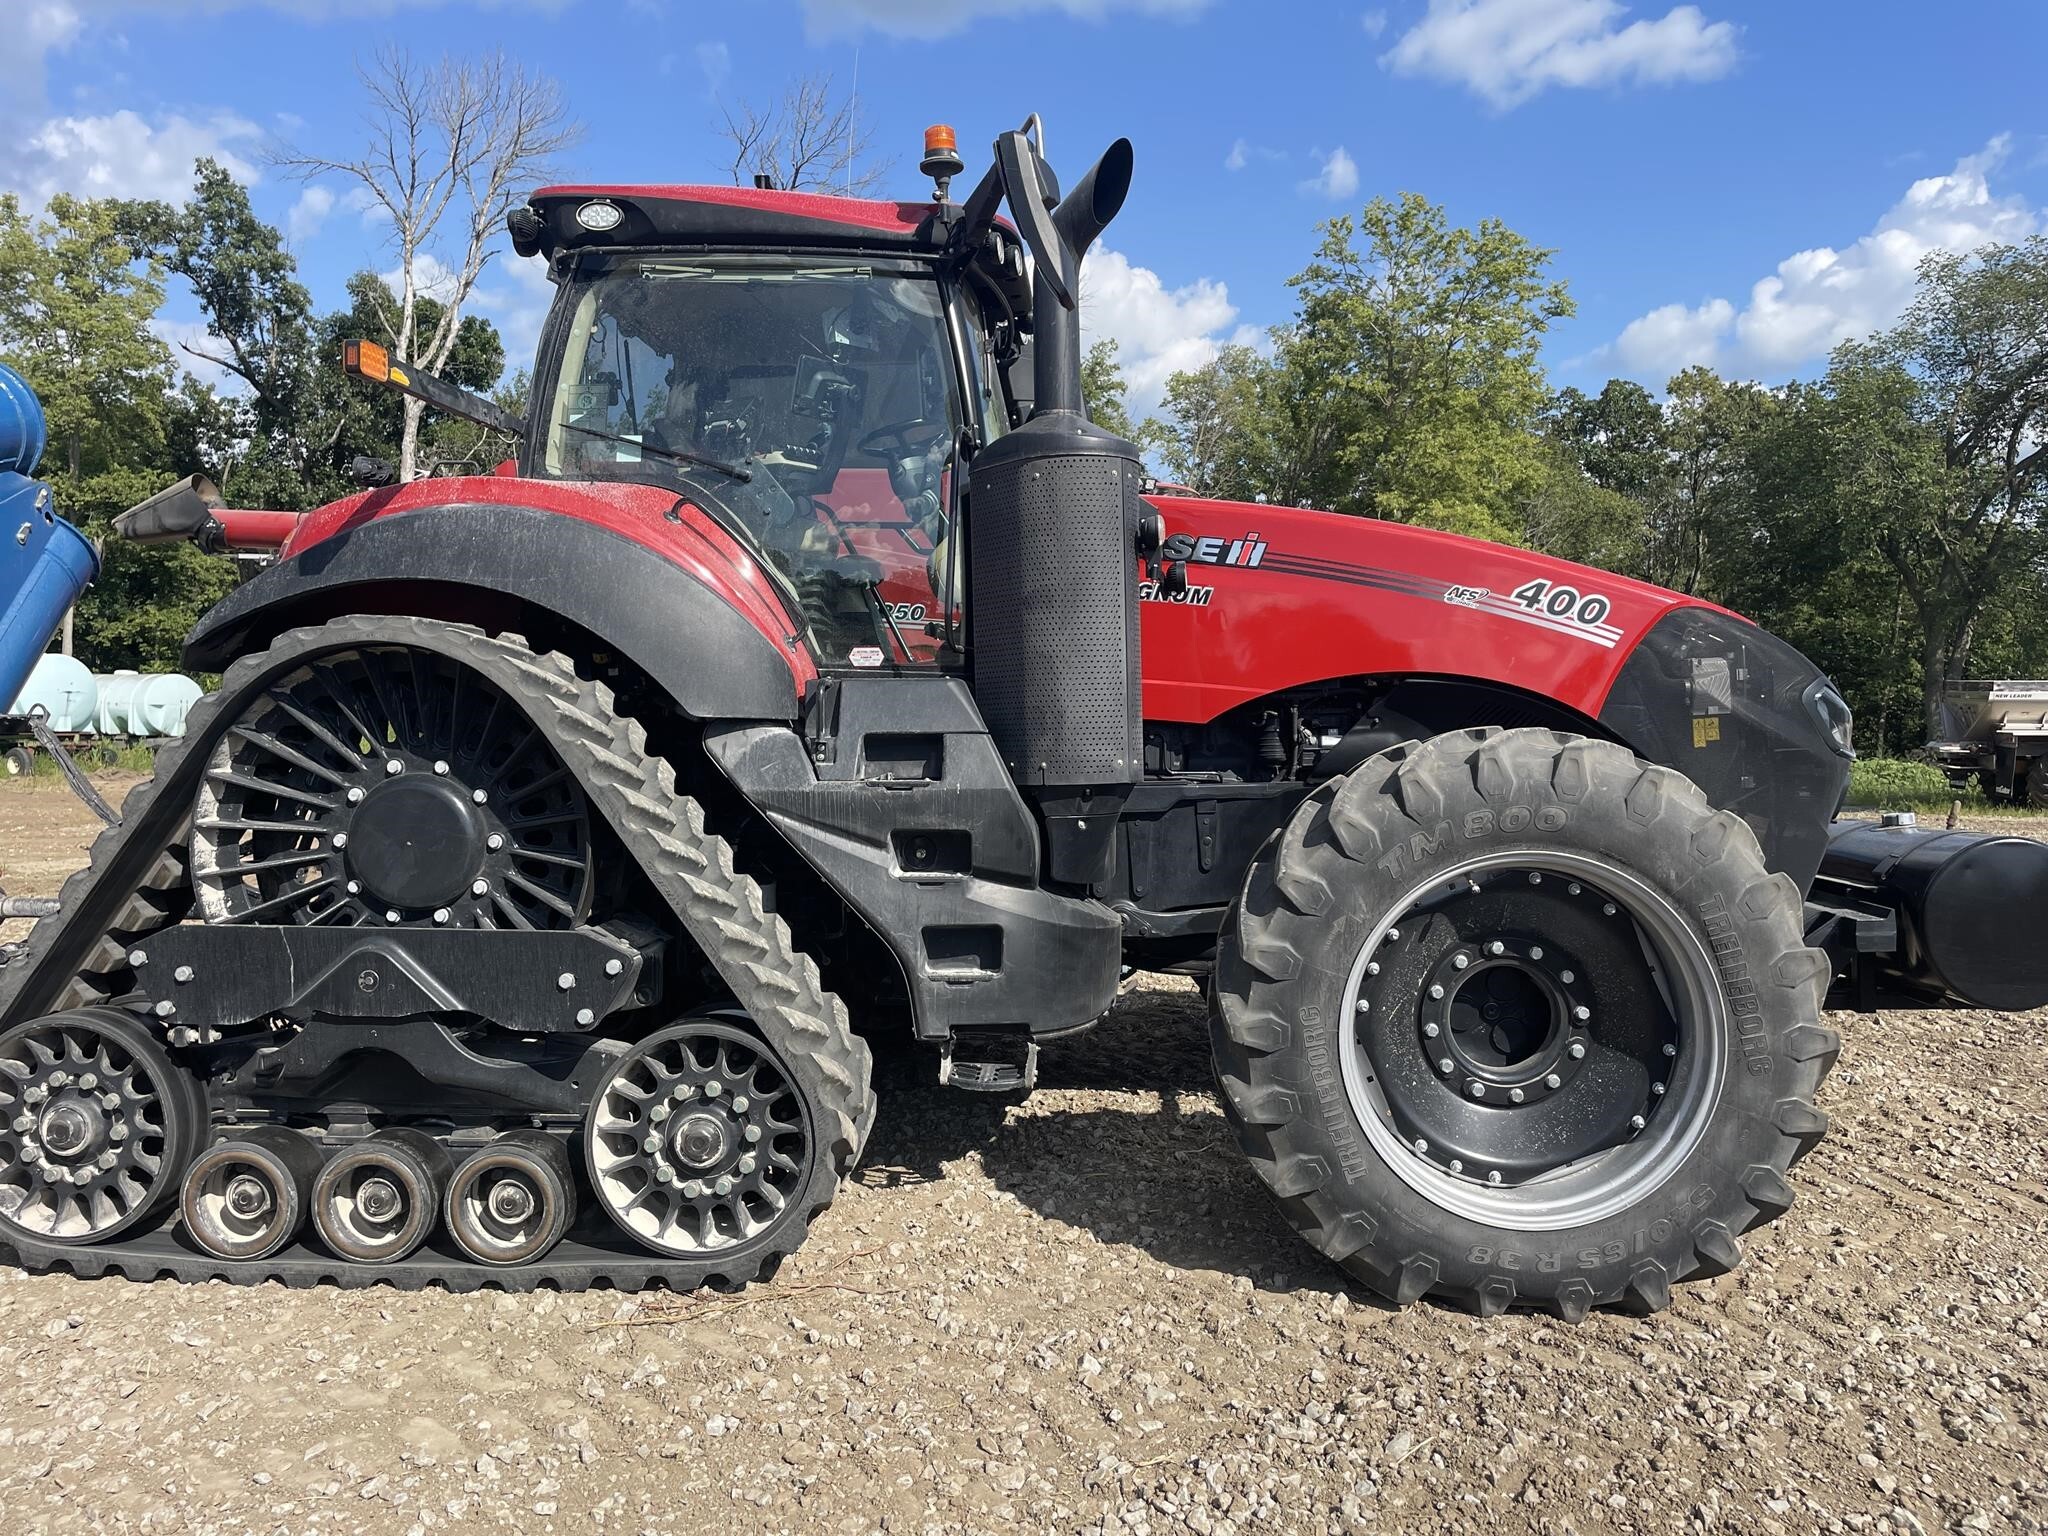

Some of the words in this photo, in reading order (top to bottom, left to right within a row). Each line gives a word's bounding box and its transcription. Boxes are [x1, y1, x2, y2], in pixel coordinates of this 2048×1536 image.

[1163, 534, 1225, 563] SE
[1447, 586, 1480, 601] AFS
[1511, 578, 1610, 628] 400
[1377, 819, 1456, 879] TM
[1463, 805, 1569, 839] 800
[1698, 891, 1774, 1079] TRELLEBORG
[1299, 1005, 1369, 1185] TRELLEBORG
[1464, 1243, 1523, 1271] 38
[1535, 1251, 1561, 1273] R
